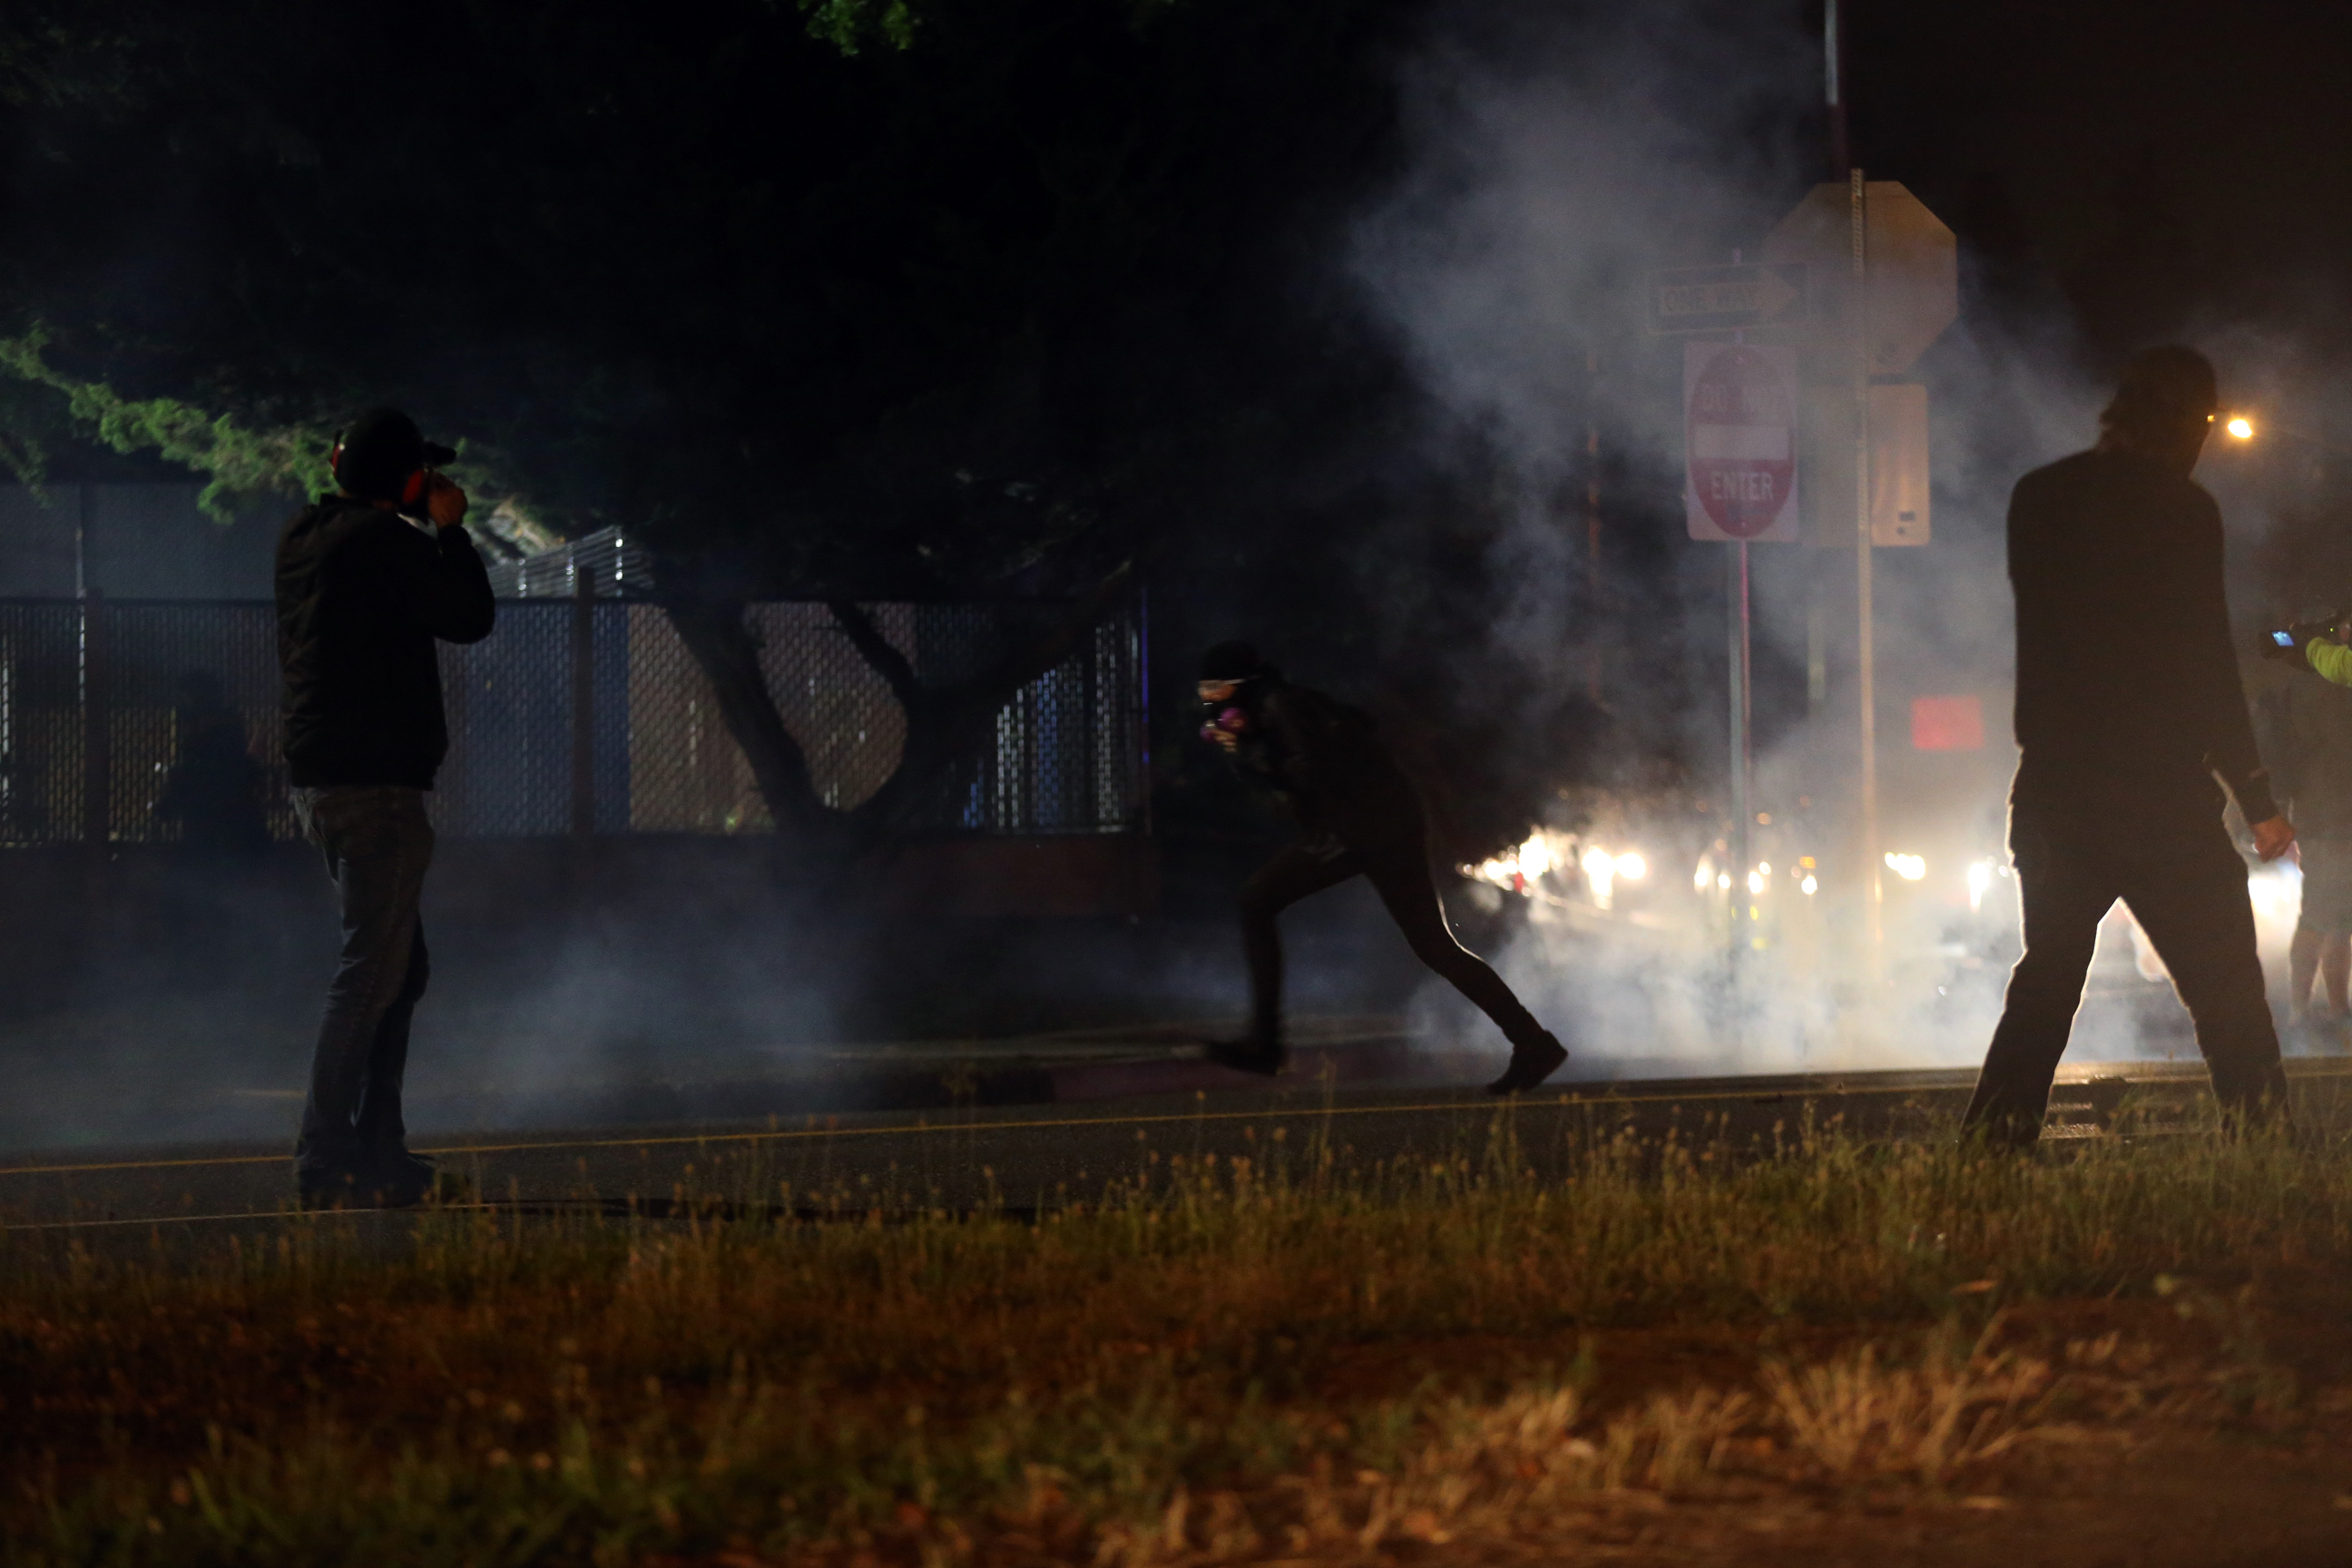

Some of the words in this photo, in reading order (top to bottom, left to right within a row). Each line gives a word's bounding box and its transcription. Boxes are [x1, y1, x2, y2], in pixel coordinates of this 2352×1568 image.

[1663, 288, 1709, 312] ONE
[1700, 383, 1727, 412] DO
[1710, 470, 1774, 501] ENTER
